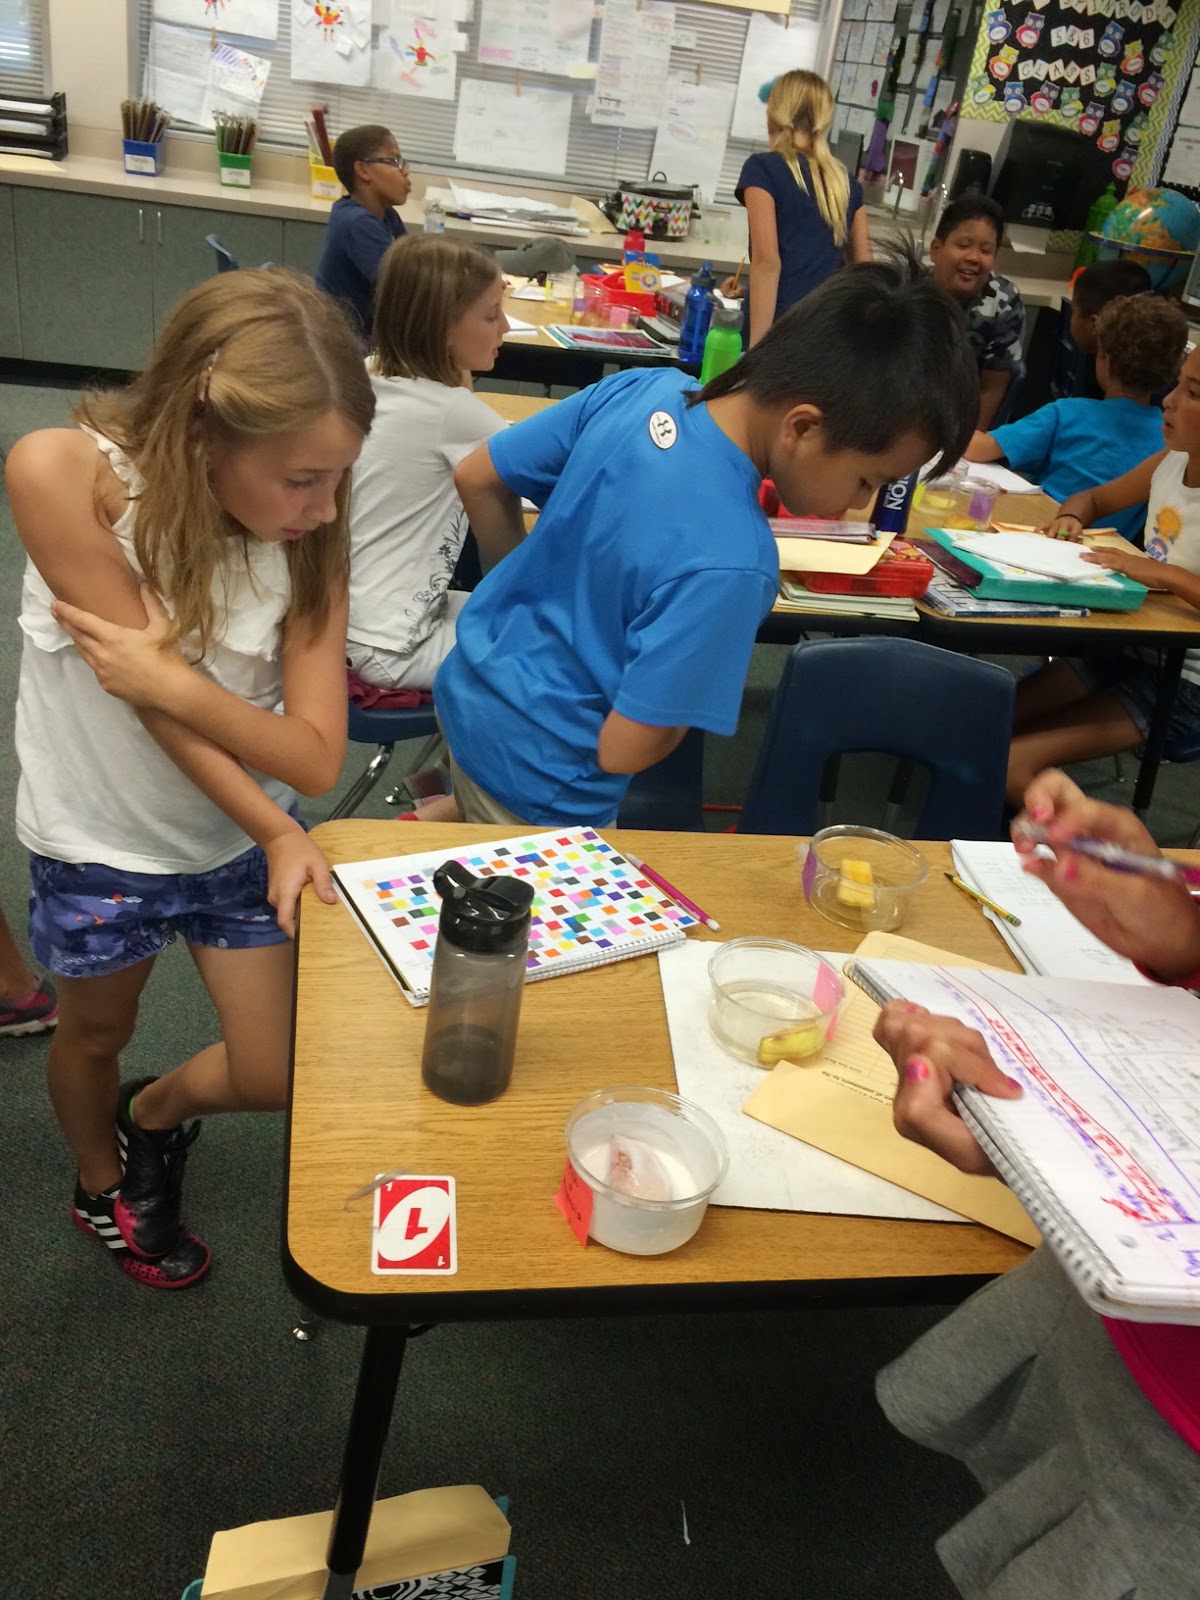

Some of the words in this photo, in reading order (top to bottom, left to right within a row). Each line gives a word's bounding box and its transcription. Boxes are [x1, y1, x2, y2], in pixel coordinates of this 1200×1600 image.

[1021, 64, 1092, 81] CLASS
[883, 475, 911, 511] ION
[404, 1207, 429, 1241] 1
